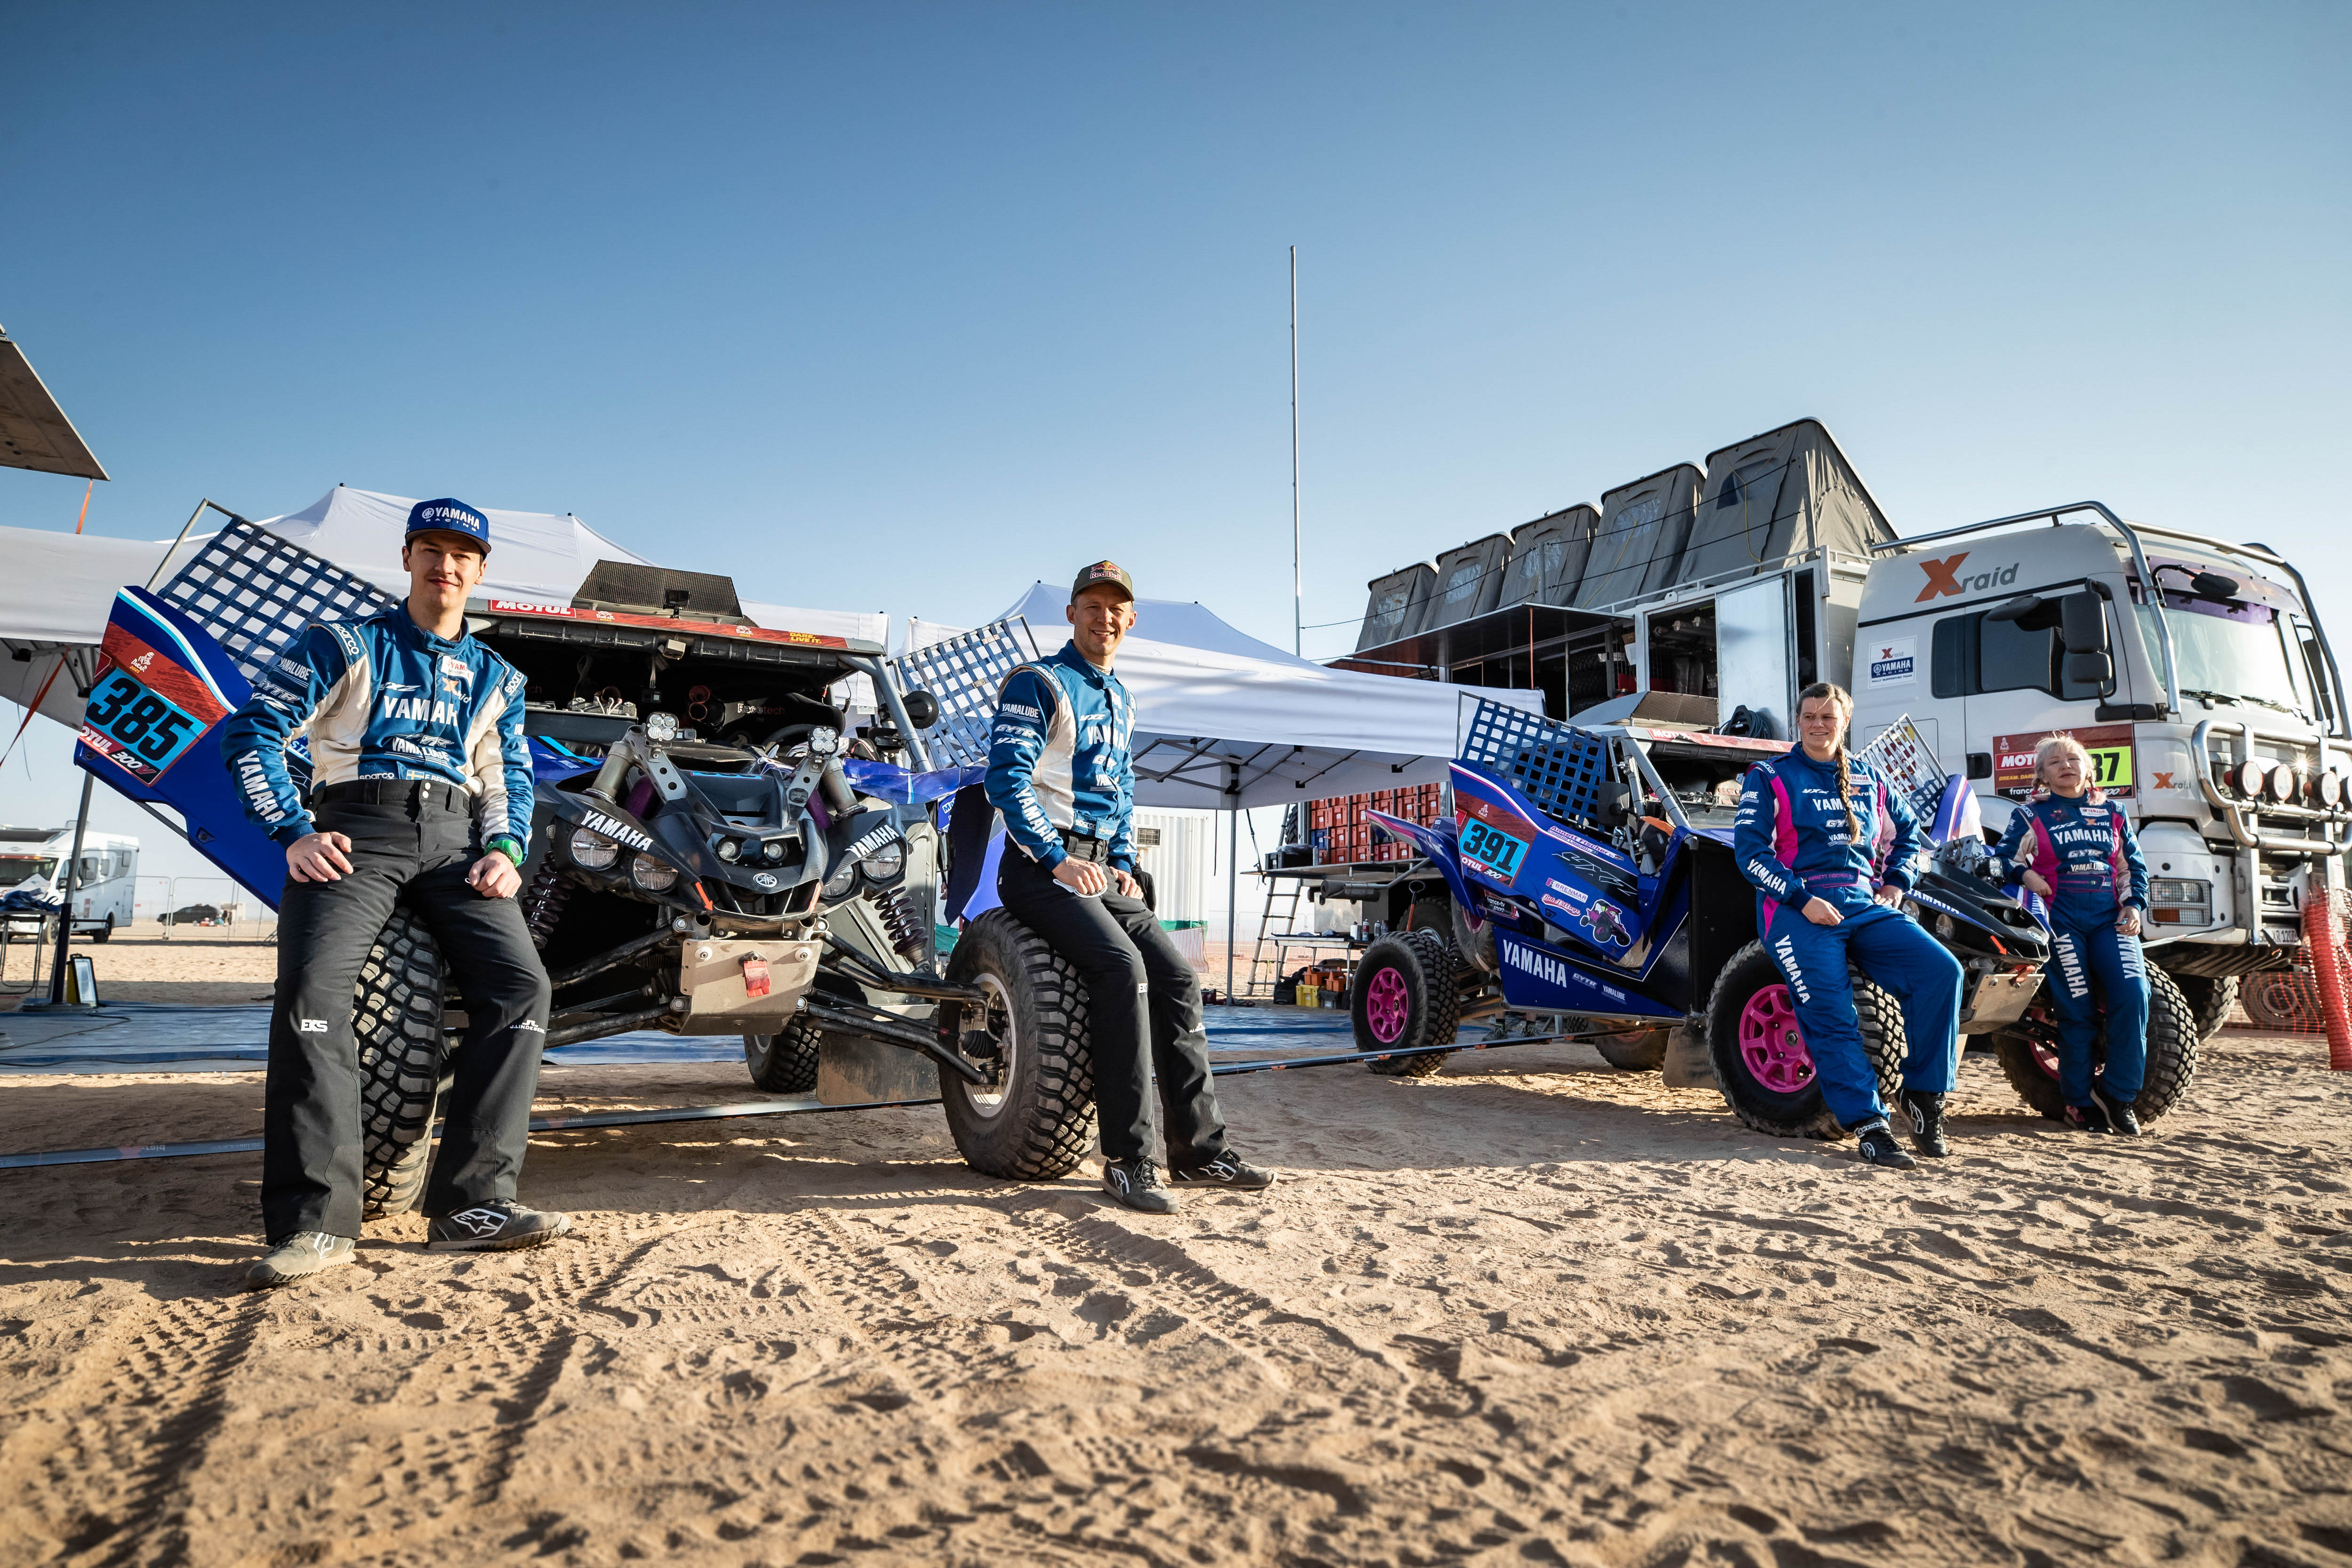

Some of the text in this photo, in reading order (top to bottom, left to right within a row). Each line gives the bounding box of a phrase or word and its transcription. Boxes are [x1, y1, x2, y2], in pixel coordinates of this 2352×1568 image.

[426, 518, 476, 532] RACING
[436, 507, 479, 530] YAMAHA
[1107, 571, 1122, 581] Bull
[1914, 551, 2019, 603] X-raid
[496, 601, 571, 614] MOTUL
[330, 623, 359, 655] sparco
[1882, 647, 1904, 659] X-raid
[129, 665, 141, 674] 2021
[131, 658, 148, 673] DAKAR
[278, 657, 311, 681] YAMALUBE
[1882, 660, 1910, 671] YAMAHA
[1035, 666, 1062, 692] sparco
[87, 677, 193, 761] 385
[383, 695, 458, 726] YAMAH
[738, 702, 786, 715] Racetech
[1002, 703, 1039, 718] YAMALUBE
[80, 726, 113, 753] OTUL
[994, 724, 1037, 739] GYTR
[111, 752, 157, 774] 300V
[238, 750, 286, 823] YAMAHA
[1015, 786, 1057, 843] YAMAHA
[1812, 798, 1869, 813] YAMHA
[581, 810, 653, 851] YAMAHA
[845, 824, 899, 858] YAMAHA
[1549, 826, 1609, 854] Annett Fischer
[2054, 828, 2110, 844] YAMAHA
[1462, 824, 1519, 873] 391
[1461, 855, 1483, 871] OTUL
[2070, 862, 2105, 872] YAMALUBE
[1484, 868, 1510, 882] 300V
[1747, 859, 1787, 895] YAMAHA
[1555, 883, 1587, 901] BRENMAR
[1503, 939, 1567, 988] YAMAHA
[2054, 933, 2088, 998] YAMAHA
[2117, 933, 2142, 979] YAMAH
[1573, 972, 1597, 987] GYTR
[1775, 934, 1810, 1004] YAMAHA
[1603, 985, 1625, 1001] YAMALUBE
[301, 1019, 328, 1033] EKS
